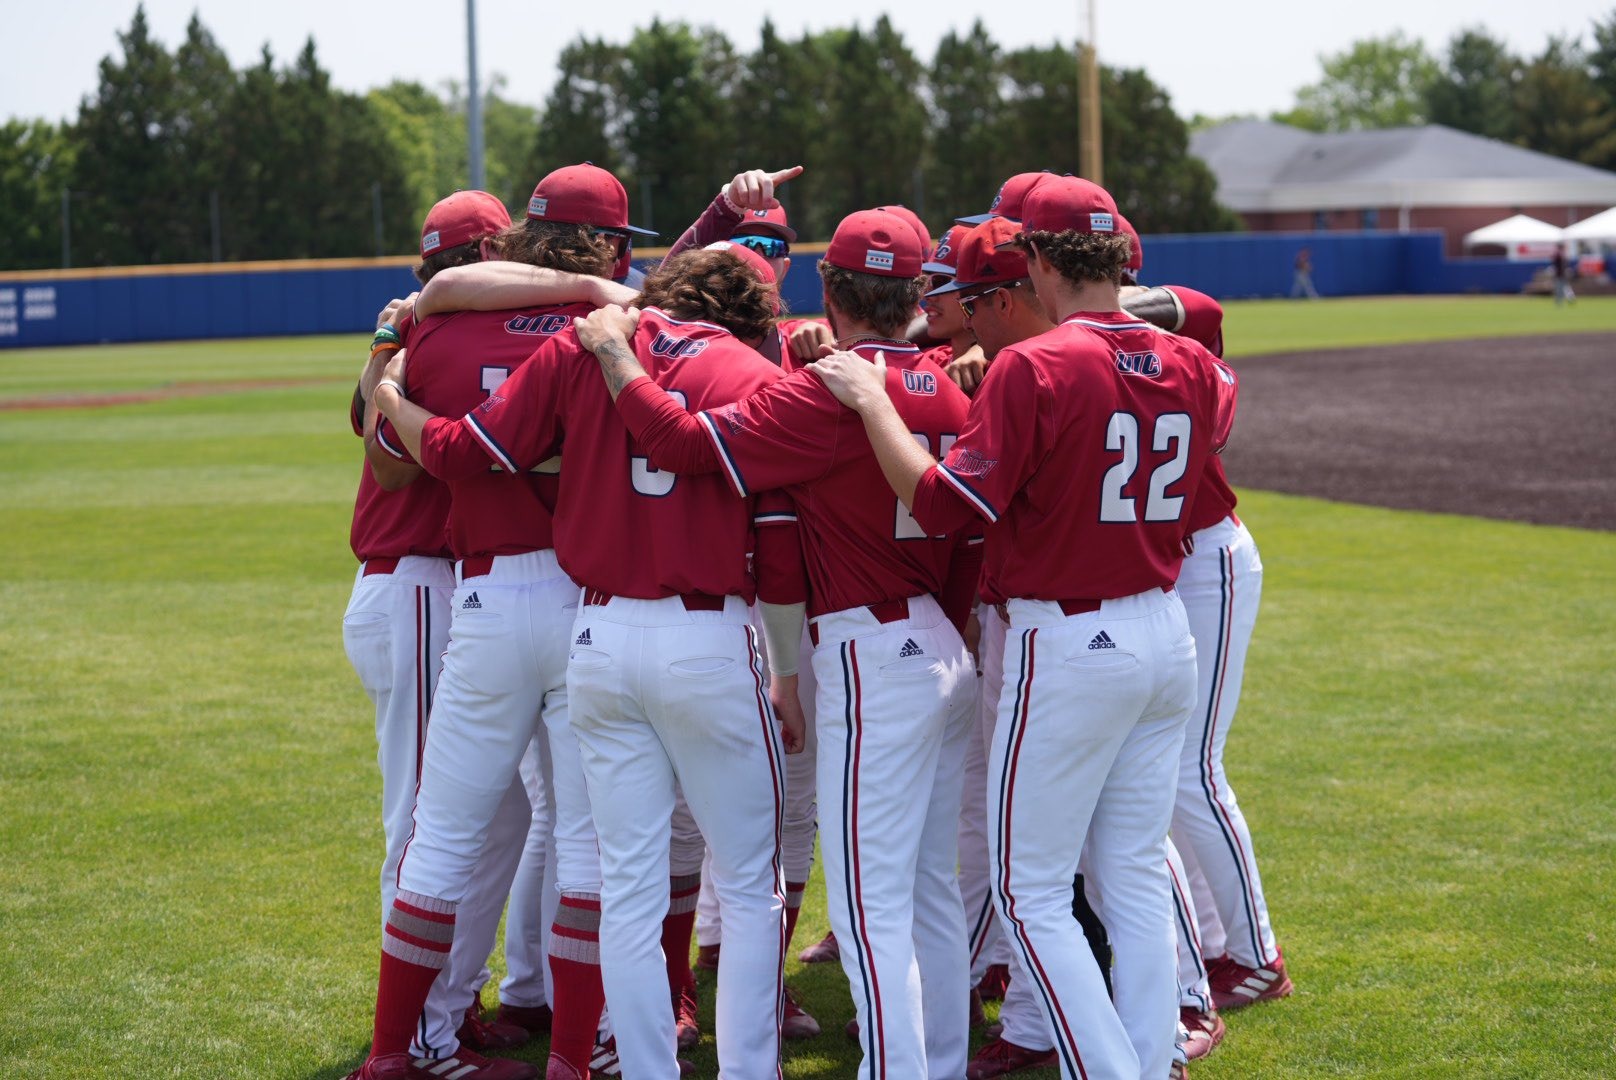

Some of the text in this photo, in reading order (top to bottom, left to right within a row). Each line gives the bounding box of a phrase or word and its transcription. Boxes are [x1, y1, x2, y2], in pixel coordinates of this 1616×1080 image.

[505, 314, 570, 336] UIC
[649, 330, 709, 359] UIC
[1115, 350, 1162, 378] UIC
[901, 368, 937, 396] UIC
[1098, 410, 1192, 523] 22
[576, 638, 592, 646] adidas
[899, 649, 924, 658] adidas
[1088, 642, 1116, 650] adidas
